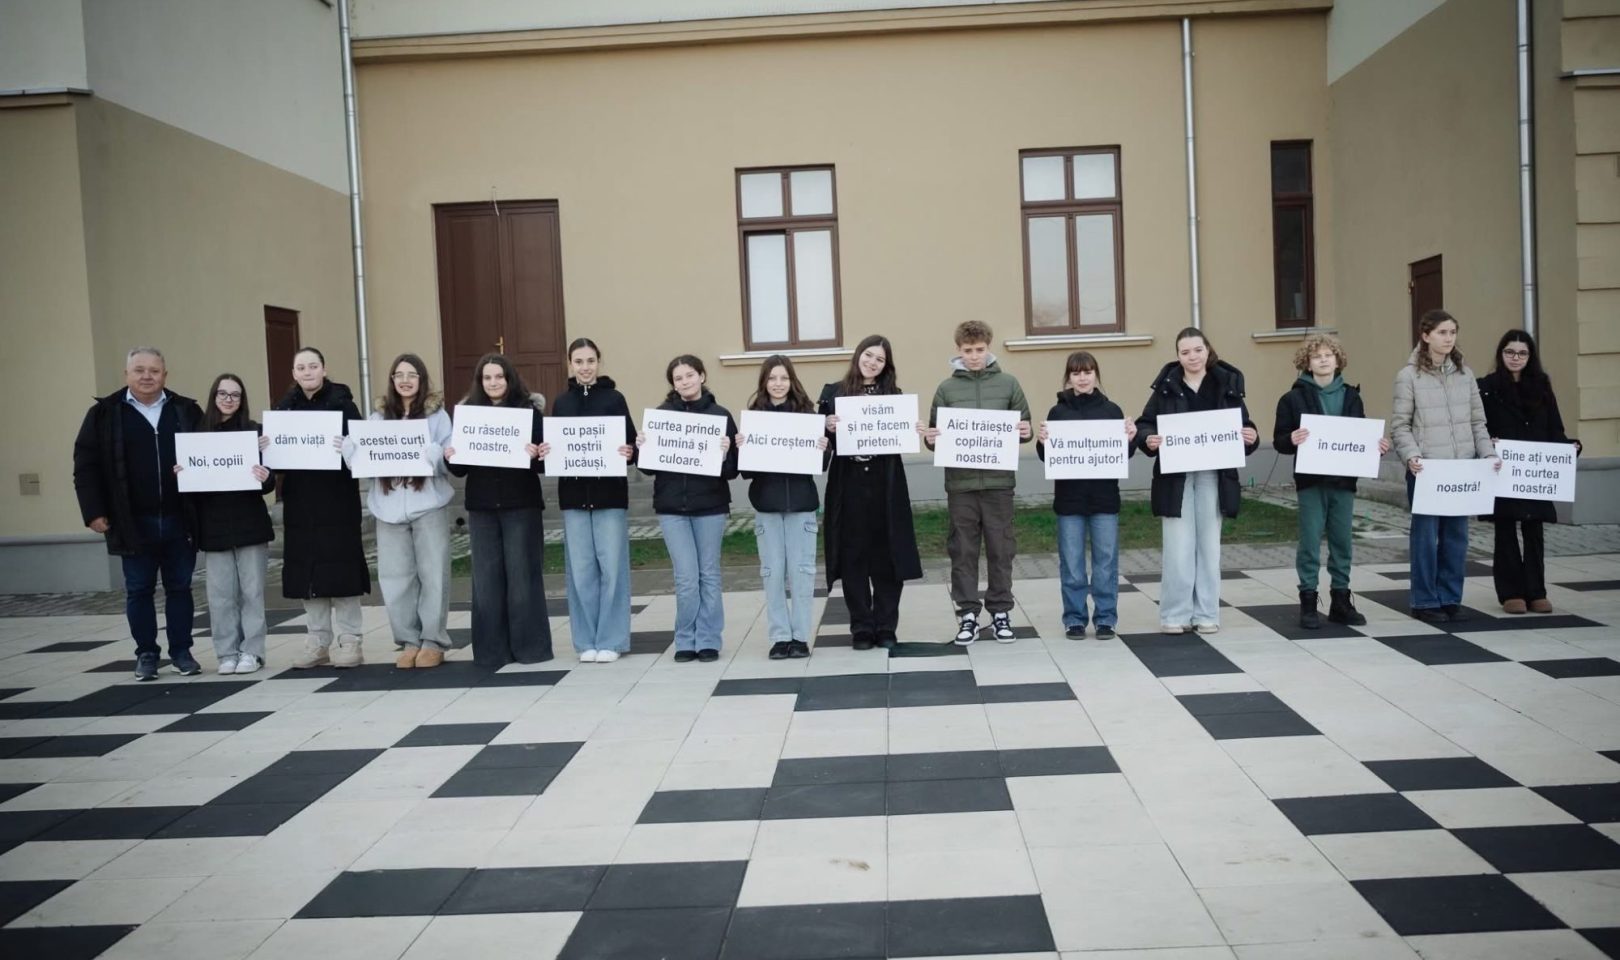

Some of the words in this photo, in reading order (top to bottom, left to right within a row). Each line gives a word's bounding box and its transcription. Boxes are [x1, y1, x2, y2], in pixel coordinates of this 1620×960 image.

[861, 403, 895, 416] visăm
[462, 425, 476, 435] cu
[562, 426, 576, 437] cu
[578, 423, 606, 439] pașii
[647, 420, 683, 433] curtea
[684, 422, 721, 437] prinde
[847, 420, 858, 436] și
[860, 422, 874, 432] ne
[876, 419, 910, 431] facem
[946, 418, 969, 431] Aici
[971, 420, 1013, 436] trăiește
[274, 433, 298, 446] dăm
[300, 433, 326, 449] viață
[359, 434, 399, 447] acestei
[400, 433, 426, 448] curți
[657, 435, 695, 450] lumină
[697, 439, 708, 454] și
[745, 433, 768, 446] Aici
[954, 435, 1003, 450] copilăria
[1049, 437, 1065, 449] Vă
[1066, 436, 1123, 452] mulțumim
[1165, 434, 1191, 447] Bine
[1193, 432, 1208, 447] ați
[1210, 429, 1239, 444] venit
[1317, 438, 1329, 451] în
[1330, 441, 1366, 454] curtea
[468, 440, 512, 455] noastre,
[567, 439, 602, 455] noștrii
[188, 455, 210, 470] Noi,
[212, 454, 244, 469] copiii
[368, 449, 421, 462] frumoase
[563, 455, 607, 471] jucăuși,
[658, 450, 704, 467] culoare.
[955, 452, 1001, 465] noastră.
[1048, 453, 1085, 468] pentru
[1087, 452, 1124, 468] ajutor!
[1500, 448, 1526, 464] Bine
[1527, 451, 1543, 466] ați
[1544, 453, 1573, 465] venit
[1511, 465, 1522, 478] în
[1524, 468, 1560, 480] curtea
[1436, 480, 1481, 493] noastră!
[1512, 483, 1558, 495] noastră!
